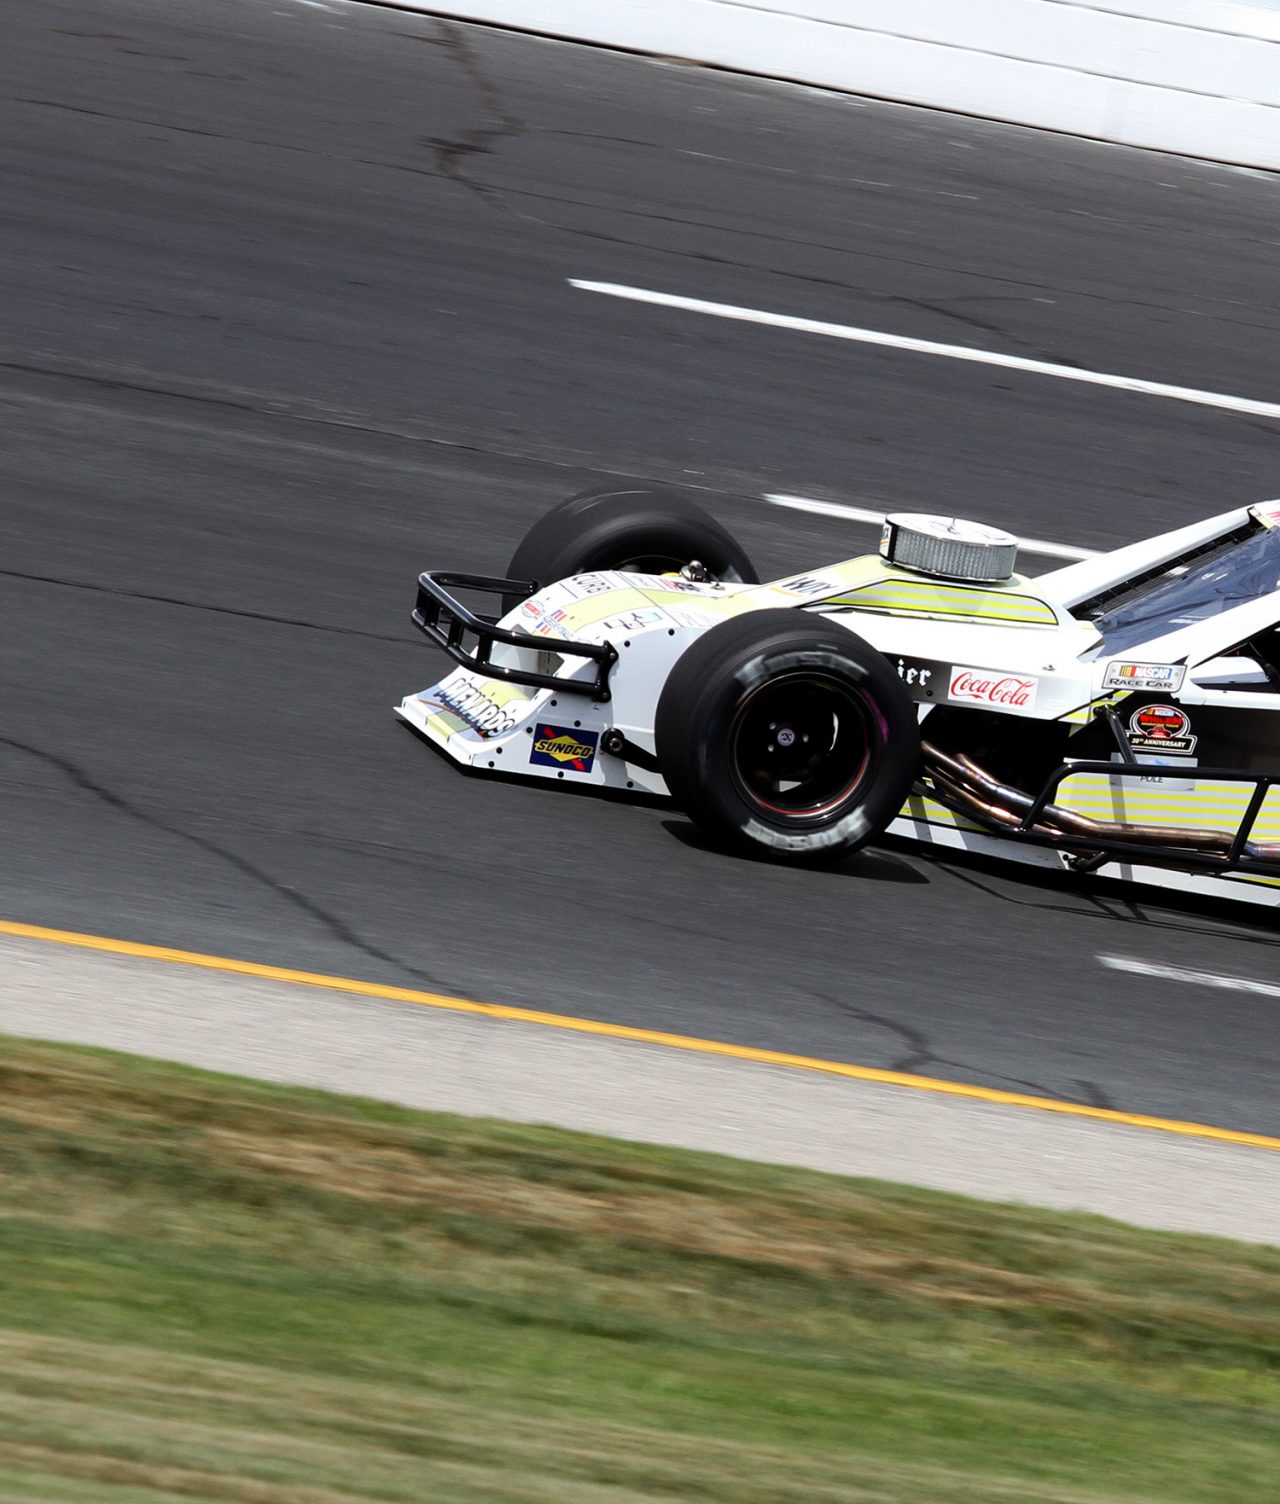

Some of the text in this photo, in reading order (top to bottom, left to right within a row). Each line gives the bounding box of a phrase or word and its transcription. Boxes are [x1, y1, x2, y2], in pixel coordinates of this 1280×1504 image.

[1132, 665, 1171, 680] NASCAR
[1109, 678, 1173, 689] RACE CAR
[432, 676, 516, 738] MENARDS
[534, 739, 594, 759] SUNOCO
[1143, 738, 1187, 748] ANNIVERSARY
